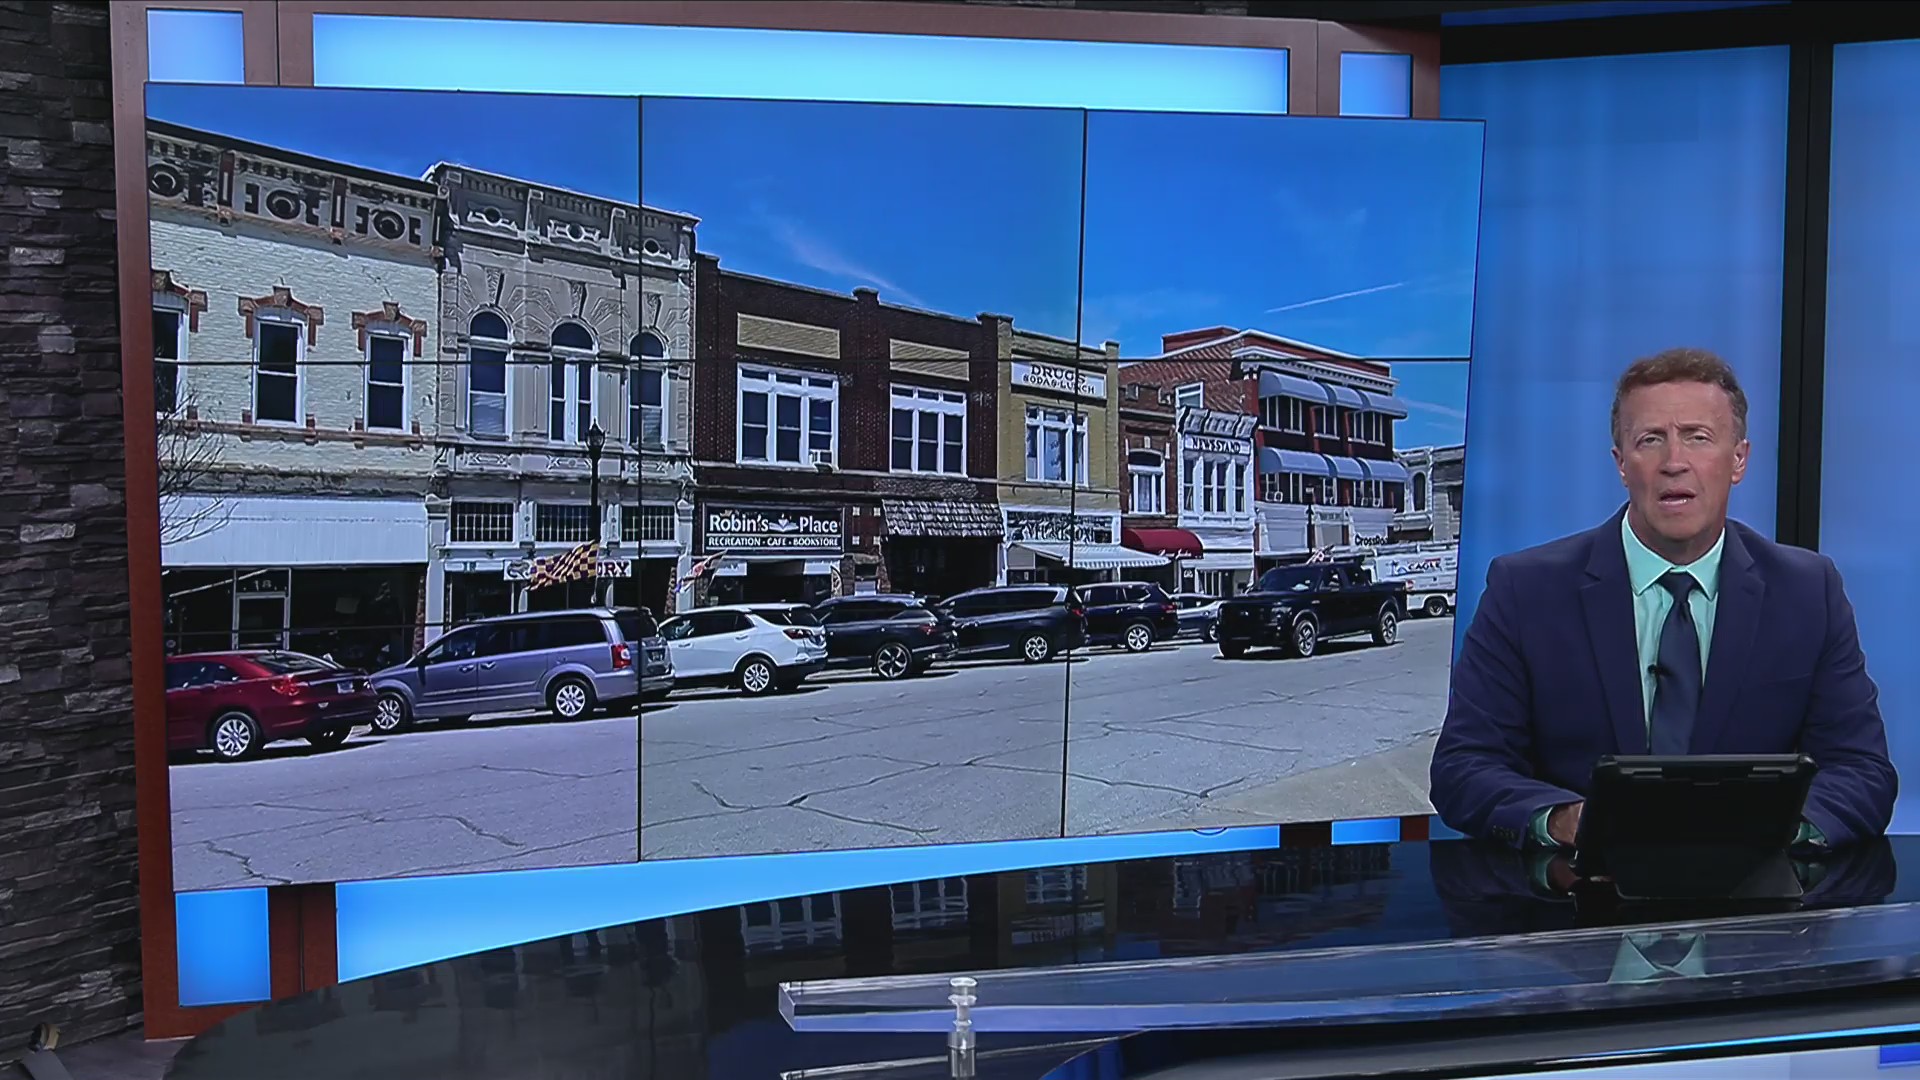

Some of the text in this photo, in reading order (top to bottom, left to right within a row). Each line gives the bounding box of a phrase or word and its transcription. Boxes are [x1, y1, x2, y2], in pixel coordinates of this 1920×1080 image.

[1031, 364, 1086, 384] DRUGS
[709, 512, 838, 533] Robin's Place
[708, 537, 761, 546] RECREATION
[793, 537, 838, 546] BOOKSTORE
